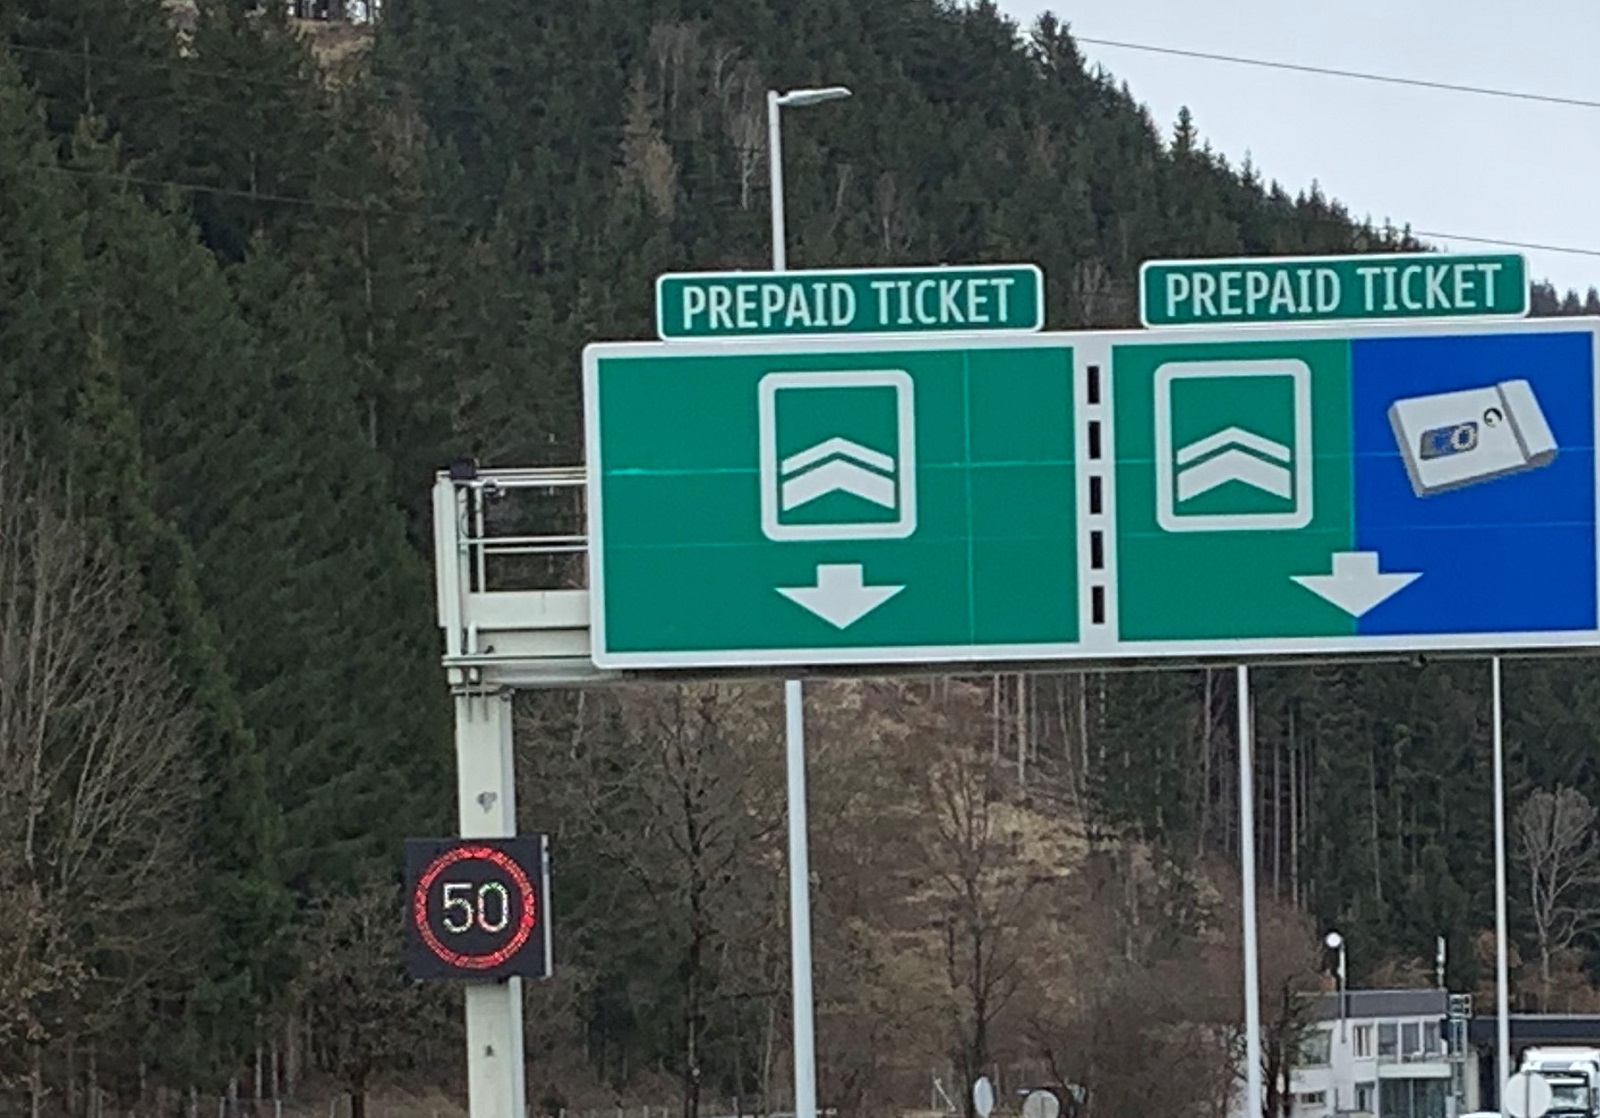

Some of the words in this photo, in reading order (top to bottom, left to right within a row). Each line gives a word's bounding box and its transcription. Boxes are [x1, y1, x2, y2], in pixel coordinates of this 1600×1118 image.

[683, 282, 855, 330] PREPAID
[872, 278, 1015, 325] TICKET
[1166, 268, 1341, 316] PREPAID
[1357, 263, 1503, 312] TICKET
[443, 882, 508, 933] 50
